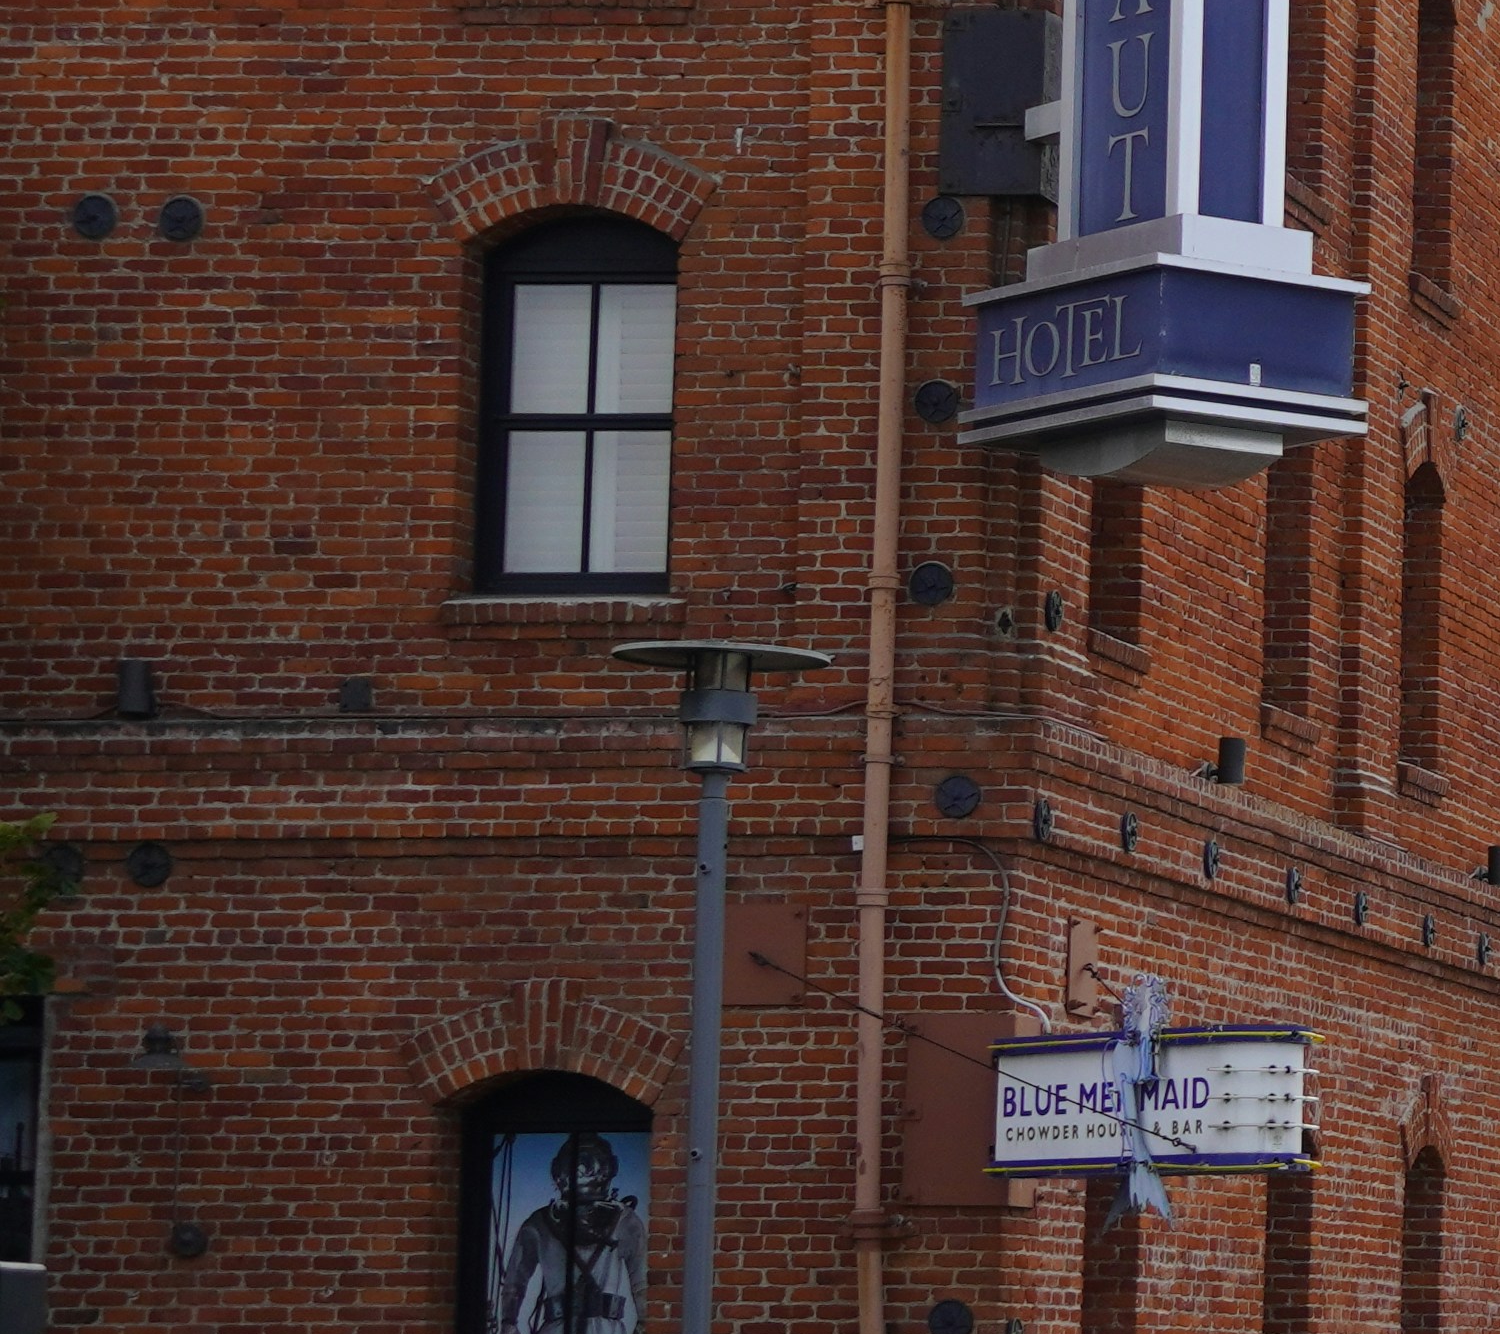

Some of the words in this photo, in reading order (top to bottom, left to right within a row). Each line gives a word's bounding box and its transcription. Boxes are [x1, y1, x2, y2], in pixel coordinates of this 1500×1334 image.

[988, 289, 1144, 389] HOTEL
[1003, 1081, 1068, 1118] BLUE
[1005, 1123, 1080, 1143] CHOWDER
[1171, 1119, 1203, 1136] BAR
